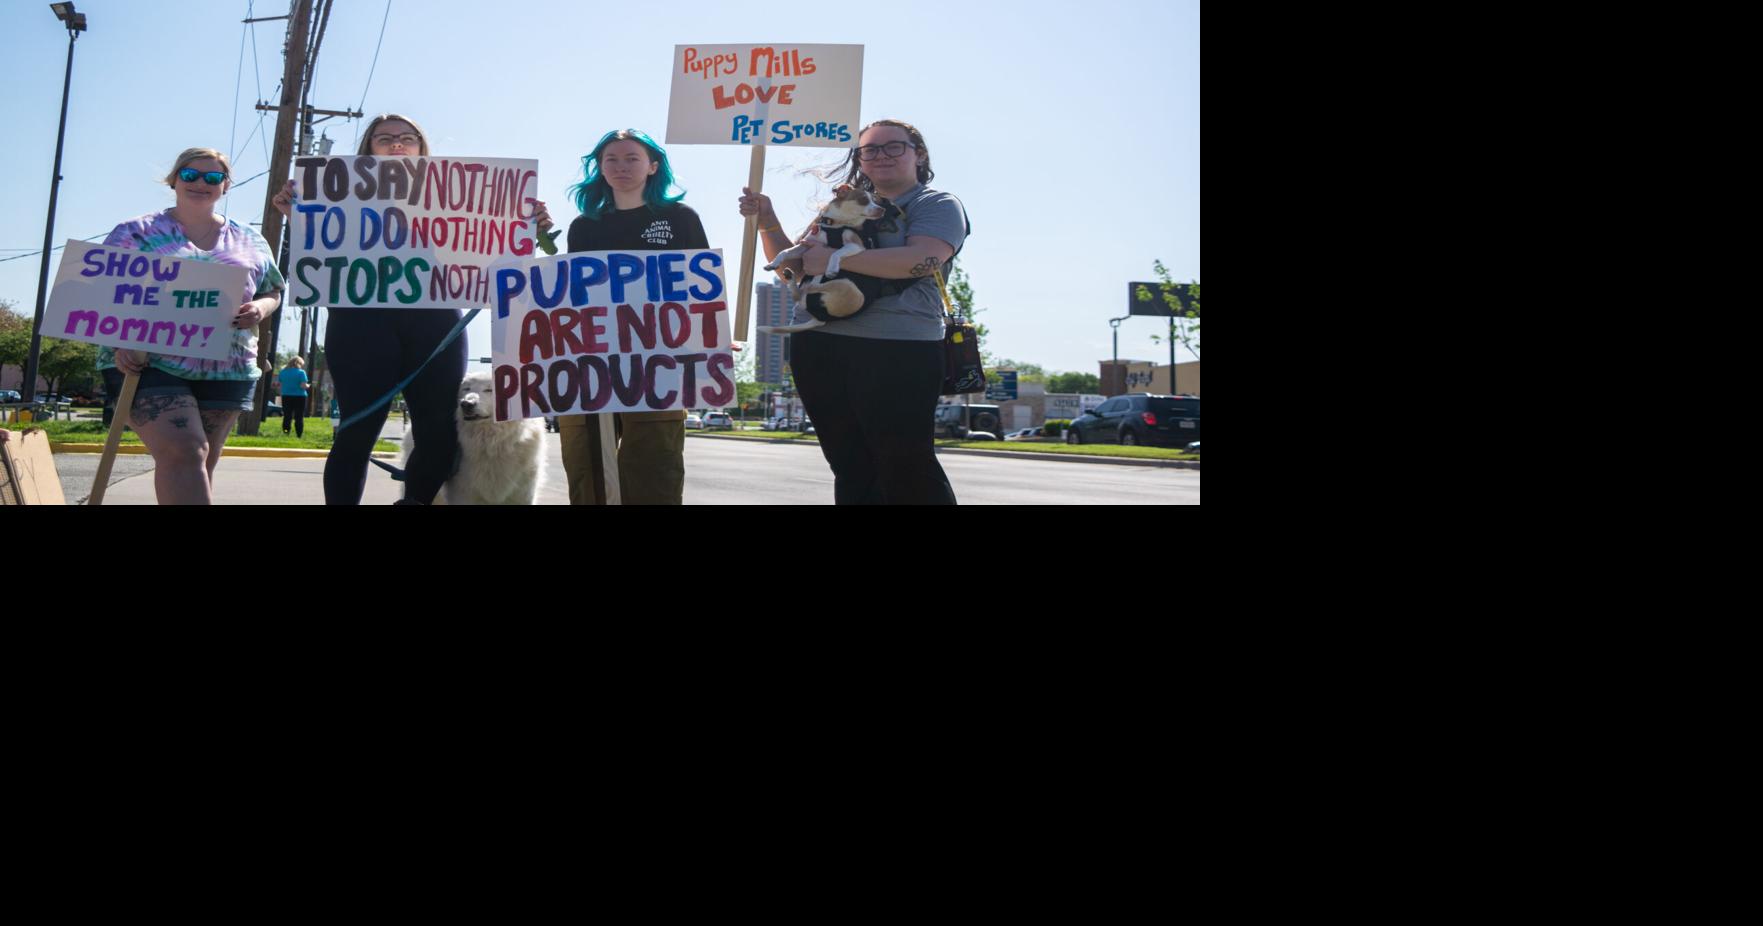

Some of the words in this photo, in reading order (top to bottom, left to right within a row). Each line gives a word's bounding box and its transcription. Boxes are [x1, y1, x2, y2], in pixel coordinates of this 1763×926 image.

[684, 48, 738, 79] Puppy
[750, 47, 816, 78] Mills
[712, 82, 796, 110] LOVE
[732, 115, 764, 144] PET
[771, 120, 851, 144] STORES
[296, 157, 350, 202] TO
[354, 156, 427, 206] SAY
[424, 159, 537, 220] NOTHING
[297, 204, 346, 250] TO
[360, 206, 408, 250] DO
[411, 216, 533, 256] NOTHING
[640, 231, 674, 239] CRUELTY
[644, 225, 671, 234] ANIMAL
[80, 249, 181, 282] SHOW
[295, 256, 430, 306] STOPS
[429, 263, 492, 304] NOTH
[113, 284, 160, 306] ME
[172, 290, 220, 308] THE
[496, 252, 724, 319] PUPPIES
[519, 306, 609, 364] ARE
[616, 301, 727, 353] NOT
[494, 353, 735, 422] PRODUCTS
